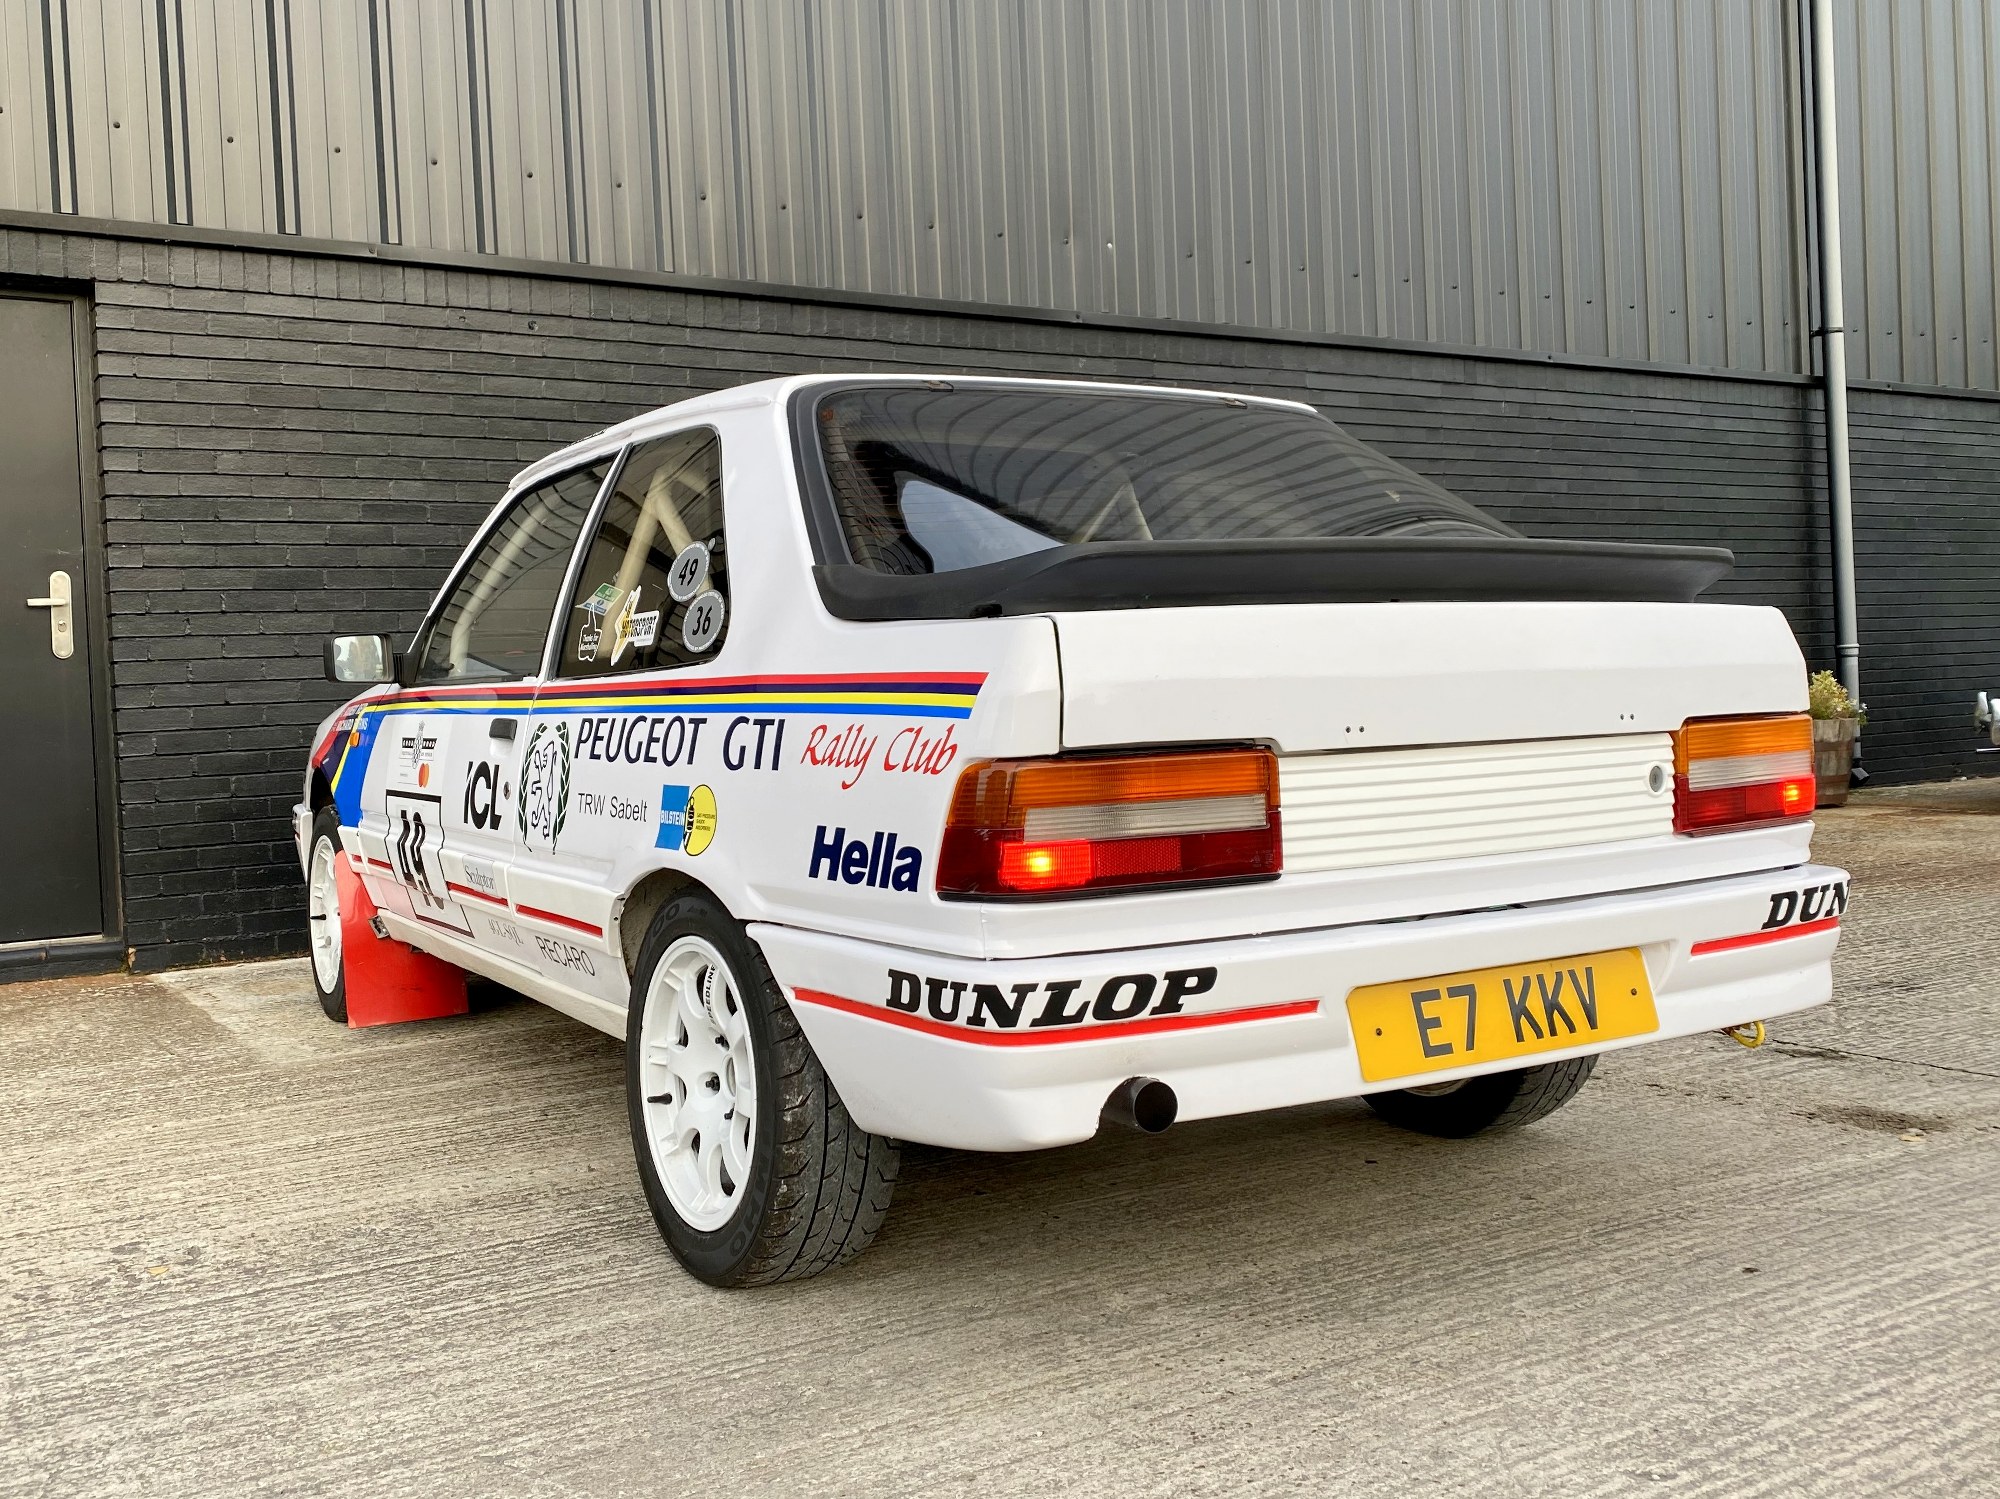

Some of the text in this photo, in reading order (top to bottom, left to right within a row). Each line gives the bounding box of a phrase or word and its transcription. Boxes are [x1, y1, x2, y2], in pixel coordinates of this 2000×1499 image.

[678, 558, 698, 586] 49
[692, 605, 712, 635] 36
[574, 715, 786, 771] PEUGEOT GTI
[800, 724, 958, 790] Rally Club
[464, 761, 502, 830] ICL
[578, 792, 648, 823] TRW Sabelt
[660, 810, 685, 826] BILSTEIN
[808, 825, 923, 893] Hella
[535, 935, 596, 977] RECARO
[705, 964, 717, 1026] SPEEDLINE
[885, 966, 1218, 1028] DUNLOP
[1410, 965, 1599, 1060] E7 KKV
